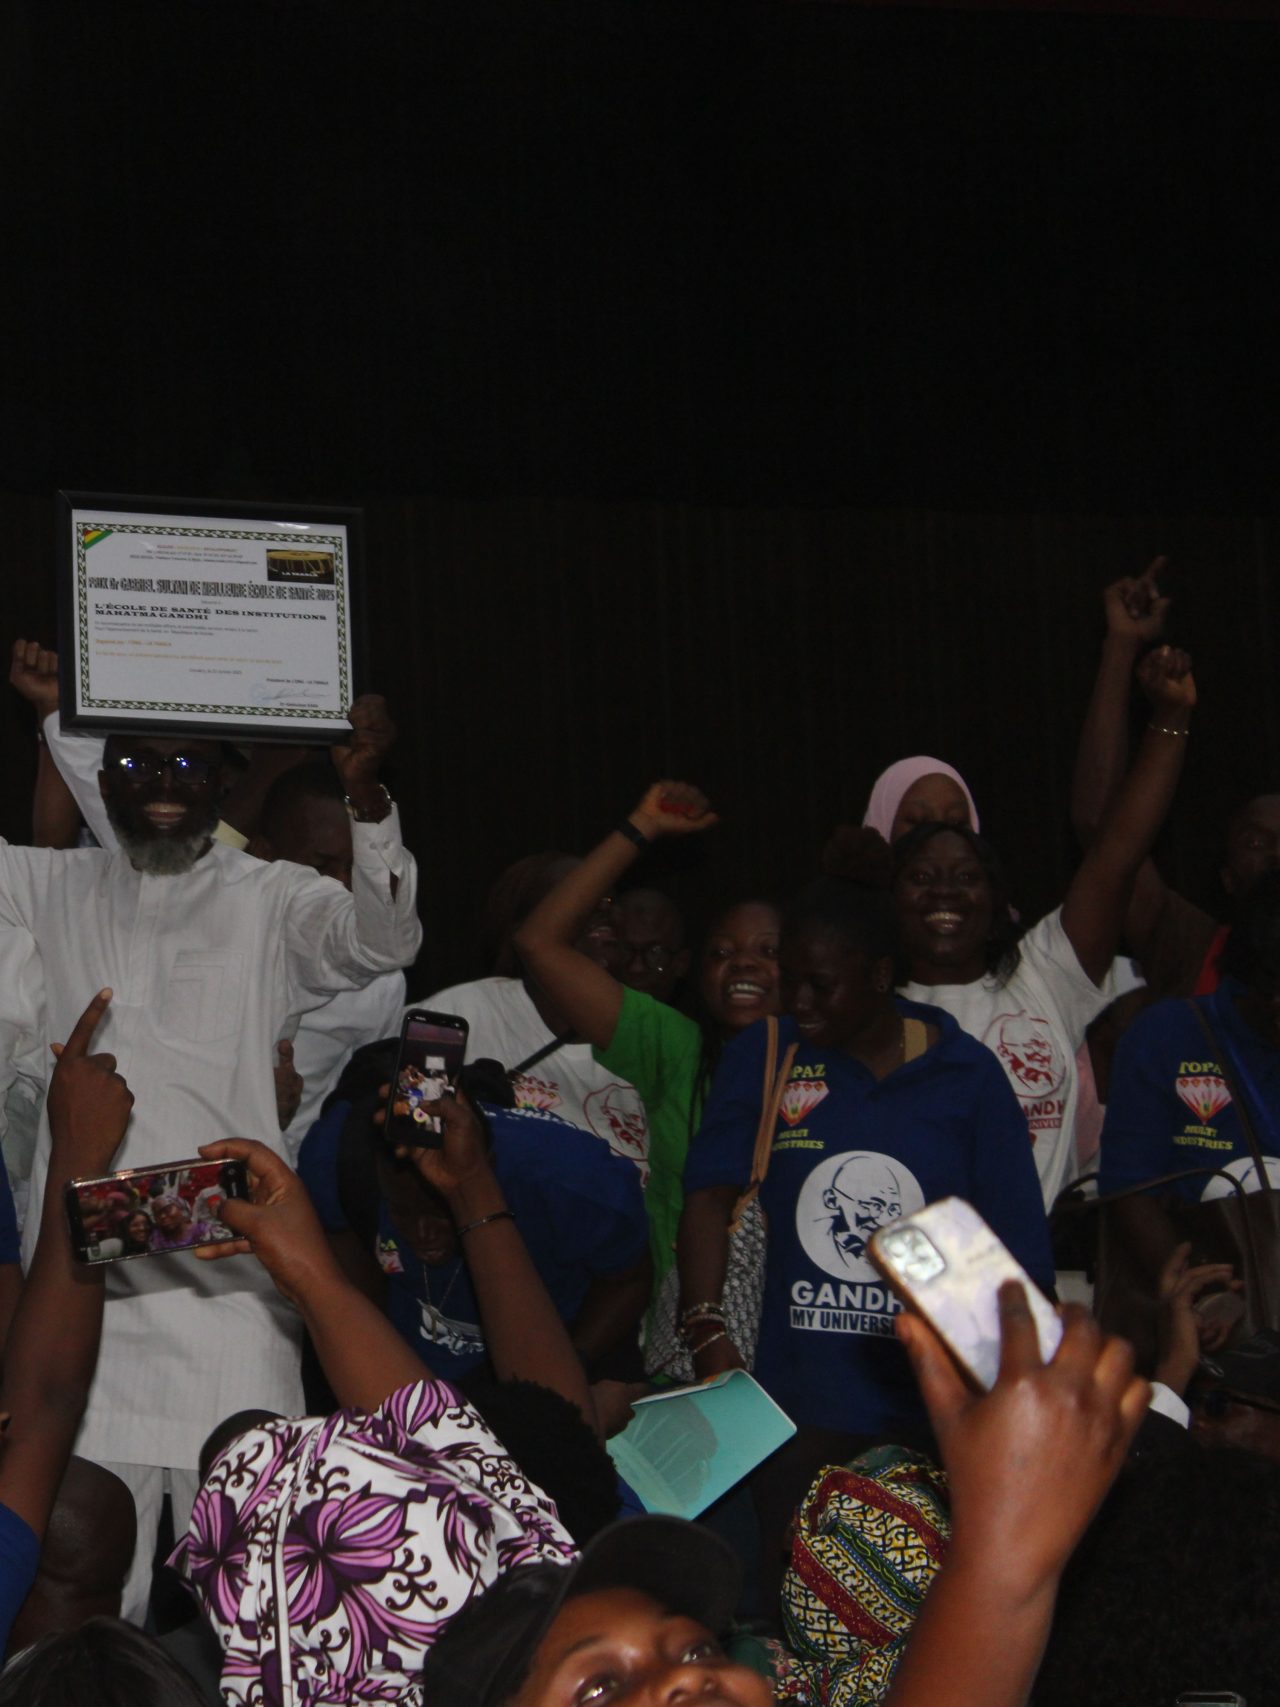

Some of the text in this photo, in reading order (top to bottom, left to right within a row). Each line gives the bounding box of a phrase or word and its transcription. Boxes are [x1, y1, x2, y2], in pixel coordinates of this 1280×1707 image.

[95, 603, 147, 611] L'ÉCOLE
[171, 606, 211, 614] SANTÉ
[242, 610, 327, 620] INSTITUTIONS
[95, 609, 209, 620] MAHATMA GANDHI
[791, 1063, 826, 1079] PAZ
[791, 1280, 906, 1314] GANDH
[792, 1308, 816, 1328] MY
